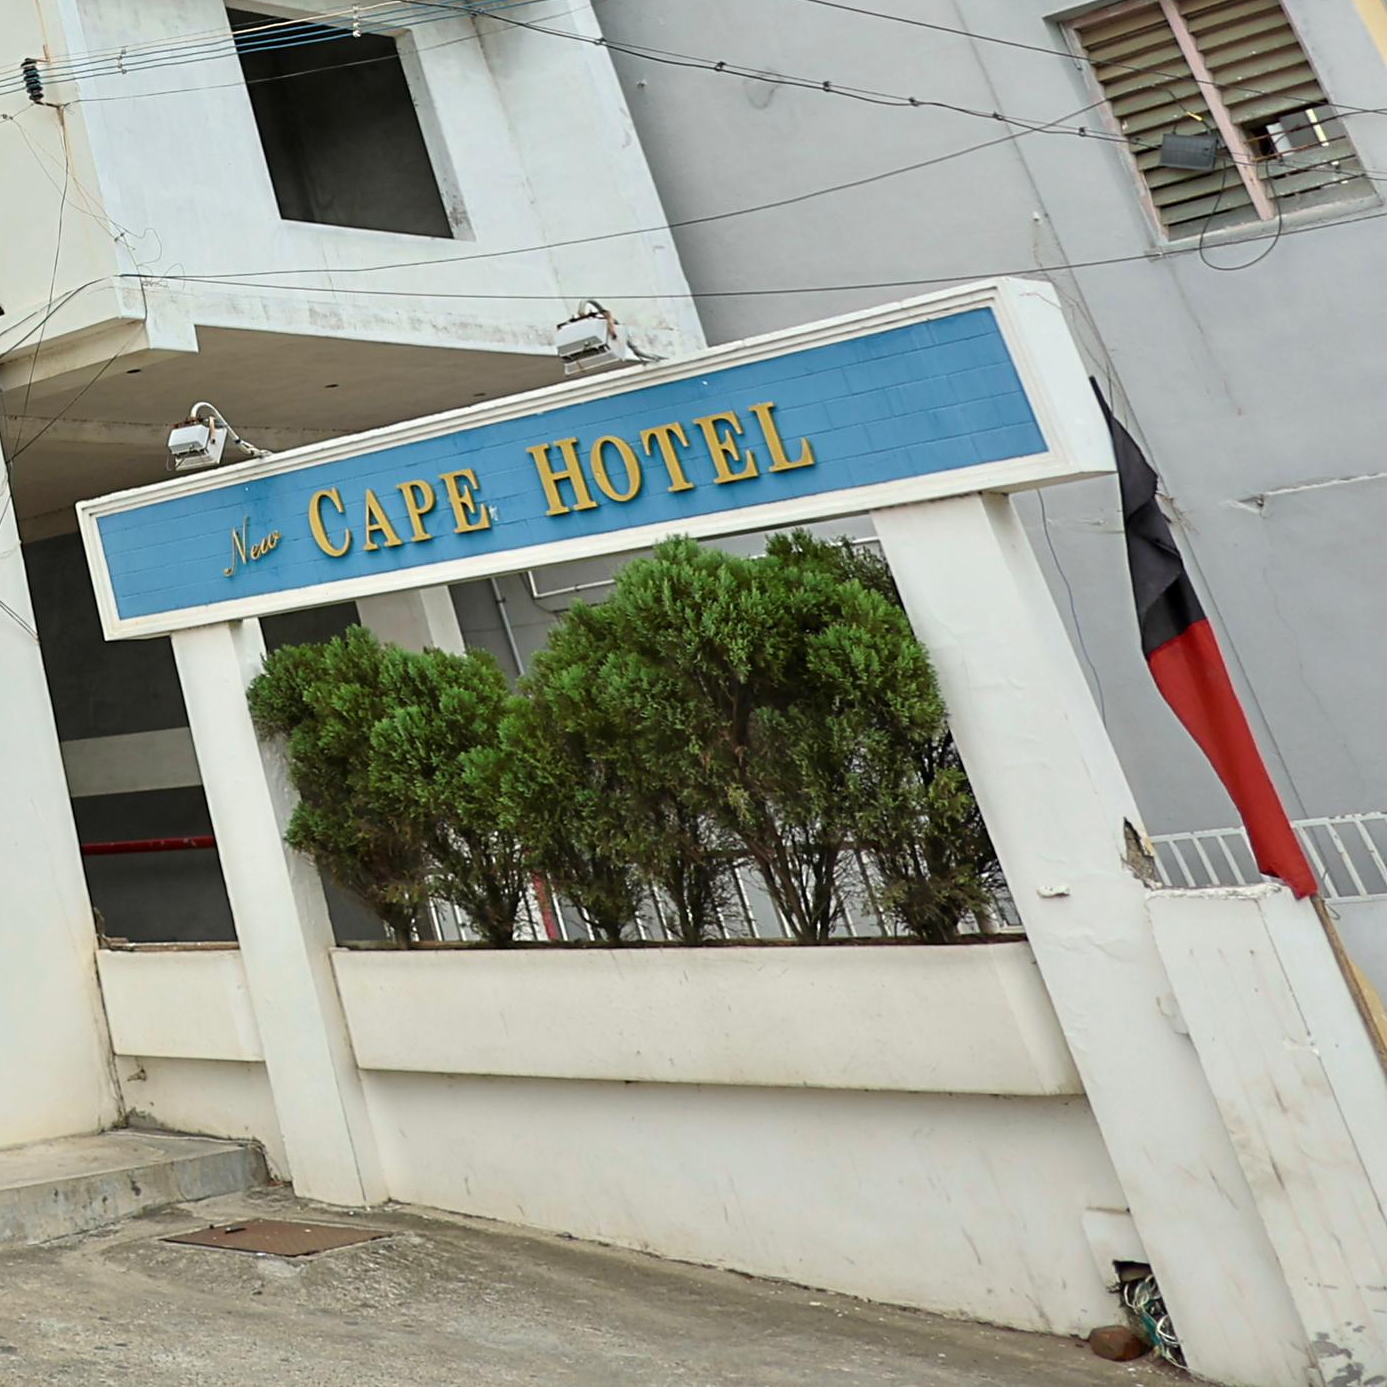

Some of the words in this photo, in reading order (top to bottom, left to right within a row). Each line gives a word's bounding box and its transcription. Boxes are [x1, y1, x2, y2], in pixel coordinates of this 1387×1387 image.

[223, 515, 281, 577] New
[308, 467, 492, 558] CAPE
[526, 401, 816, 517] HOTEL
